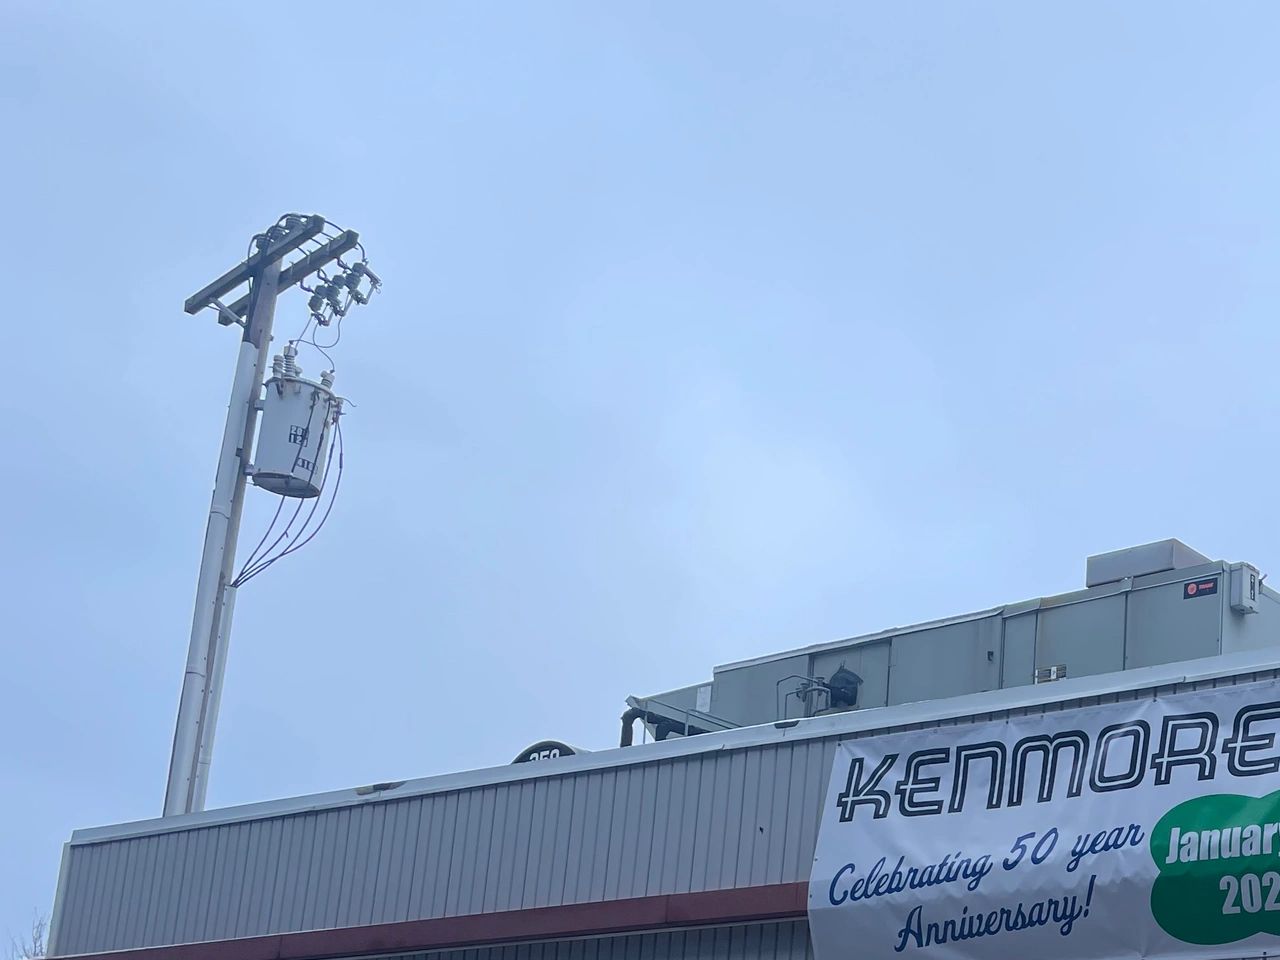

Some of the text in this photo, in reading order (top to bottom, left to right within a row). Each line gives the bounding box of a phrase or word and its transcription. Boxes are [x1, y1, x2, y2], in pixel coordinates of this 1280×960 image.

[829, 822, 1144, 906] Celebrating 50 year
[893, 874, 1098, 953] Anniversary!
